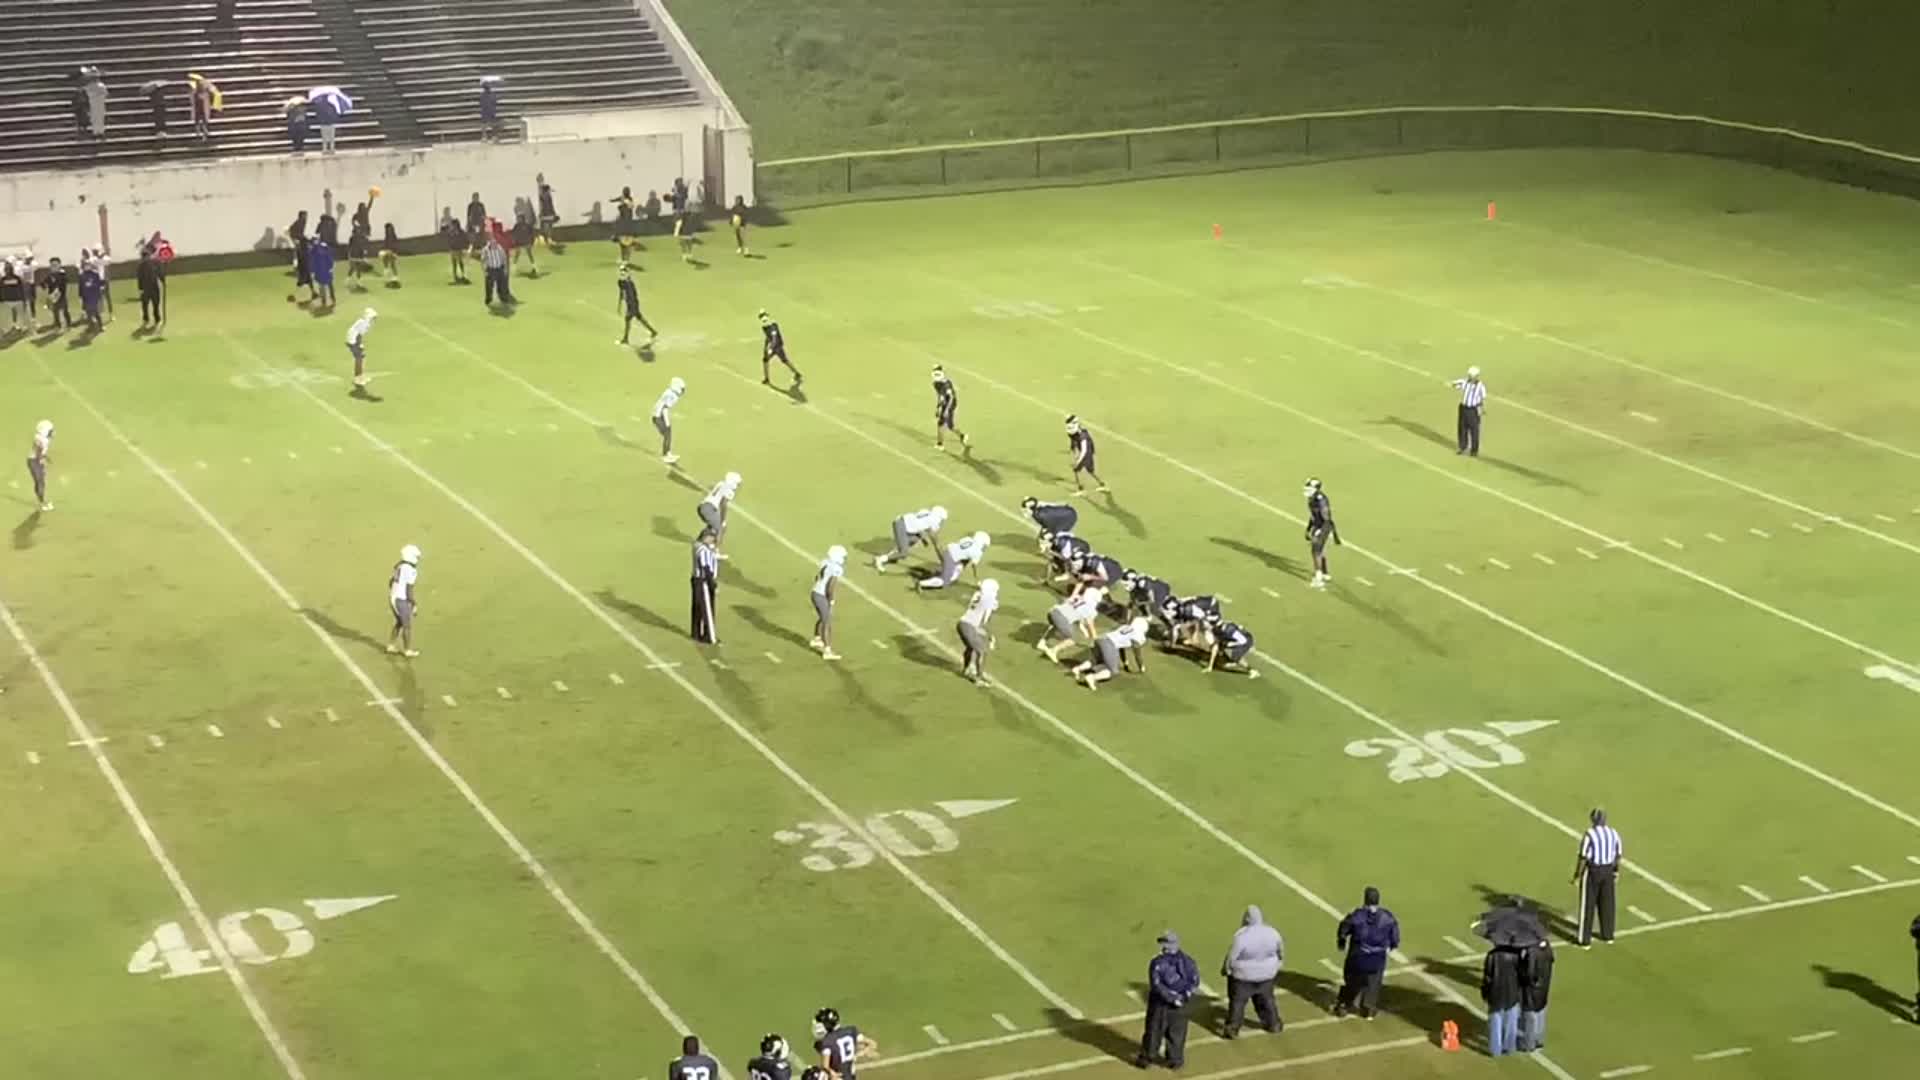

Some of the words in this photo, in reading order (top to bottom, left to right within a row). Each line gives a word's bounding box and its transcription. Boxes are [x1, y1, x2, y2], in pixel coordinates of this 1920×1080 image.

[1343, 727, 1526, 783] 20
[772, 809, 960, 872] 30
[127, 907, 315, 979] 40
